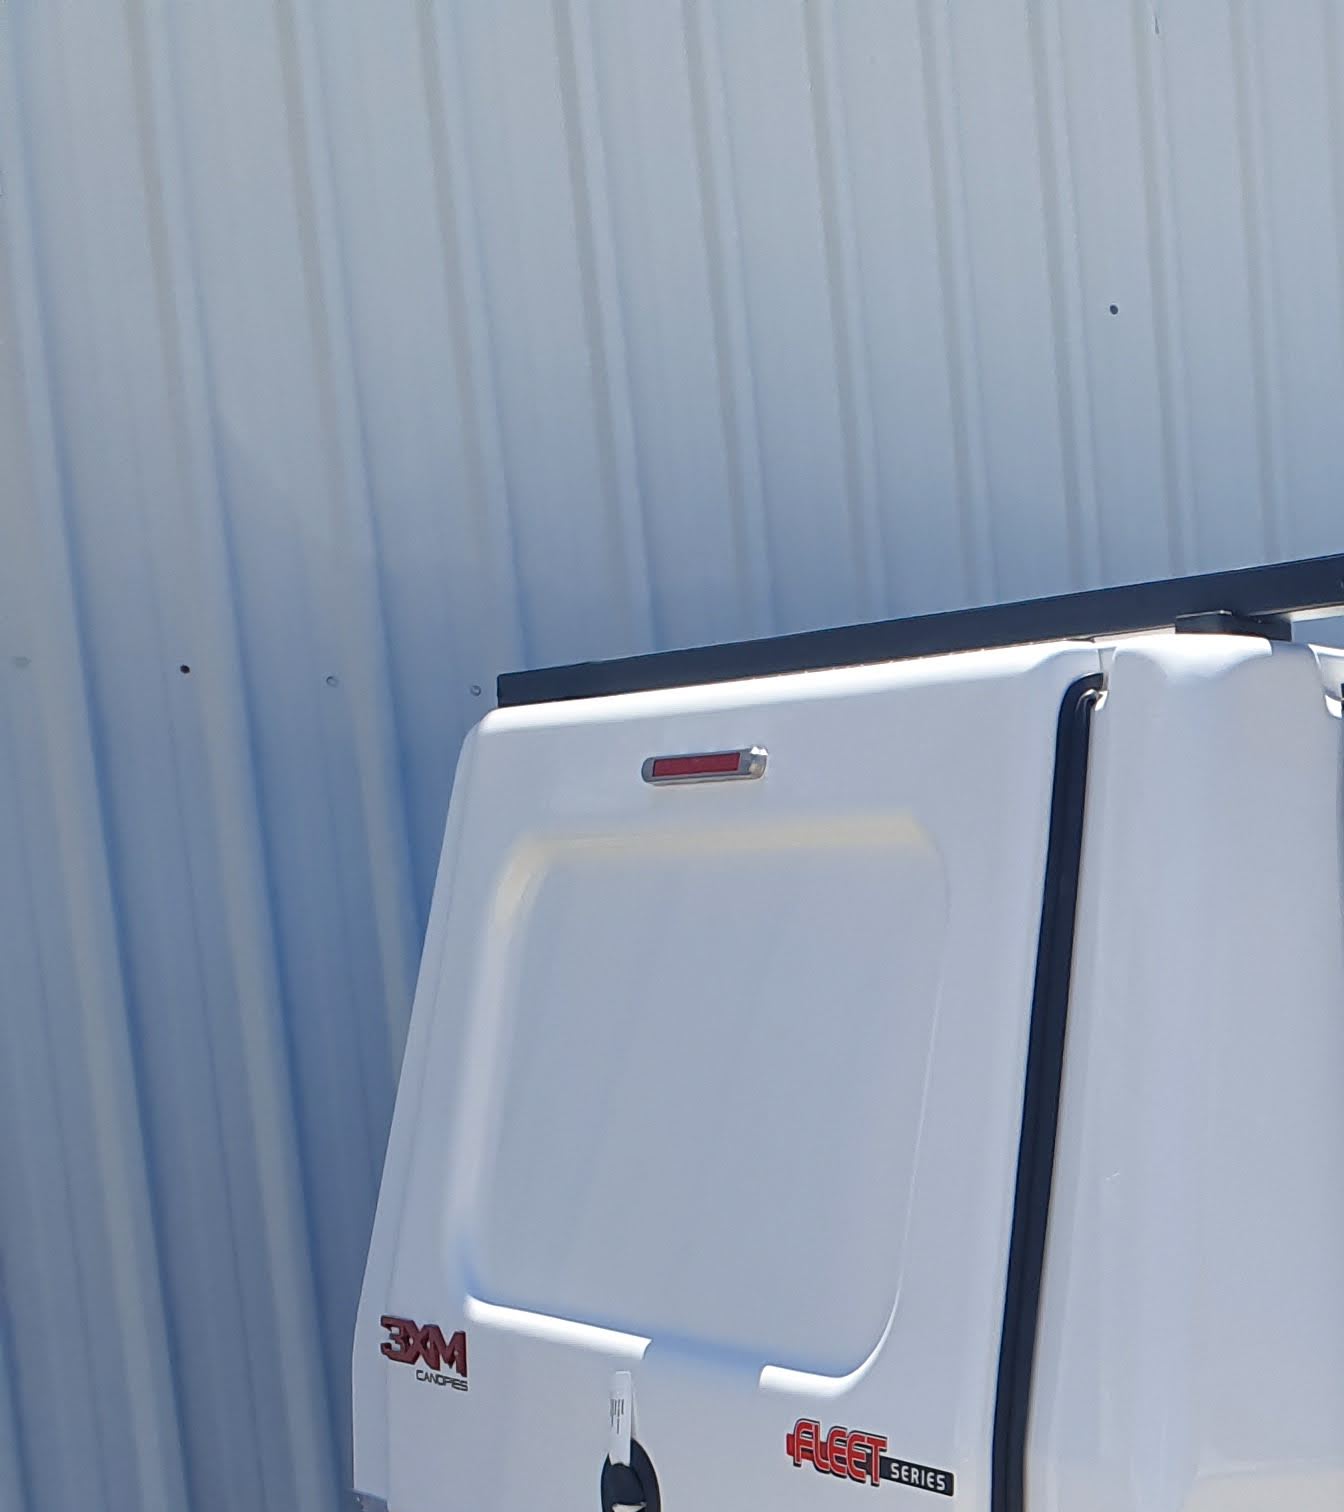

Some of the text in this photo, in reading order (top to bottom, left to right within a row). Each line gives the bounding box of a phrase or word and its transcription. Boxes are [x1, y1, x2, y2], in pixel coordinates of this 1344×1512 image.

[381, 1315, 467, 1378] 3XM
[793, 1418, 946, 1491] FLEET SERIES
